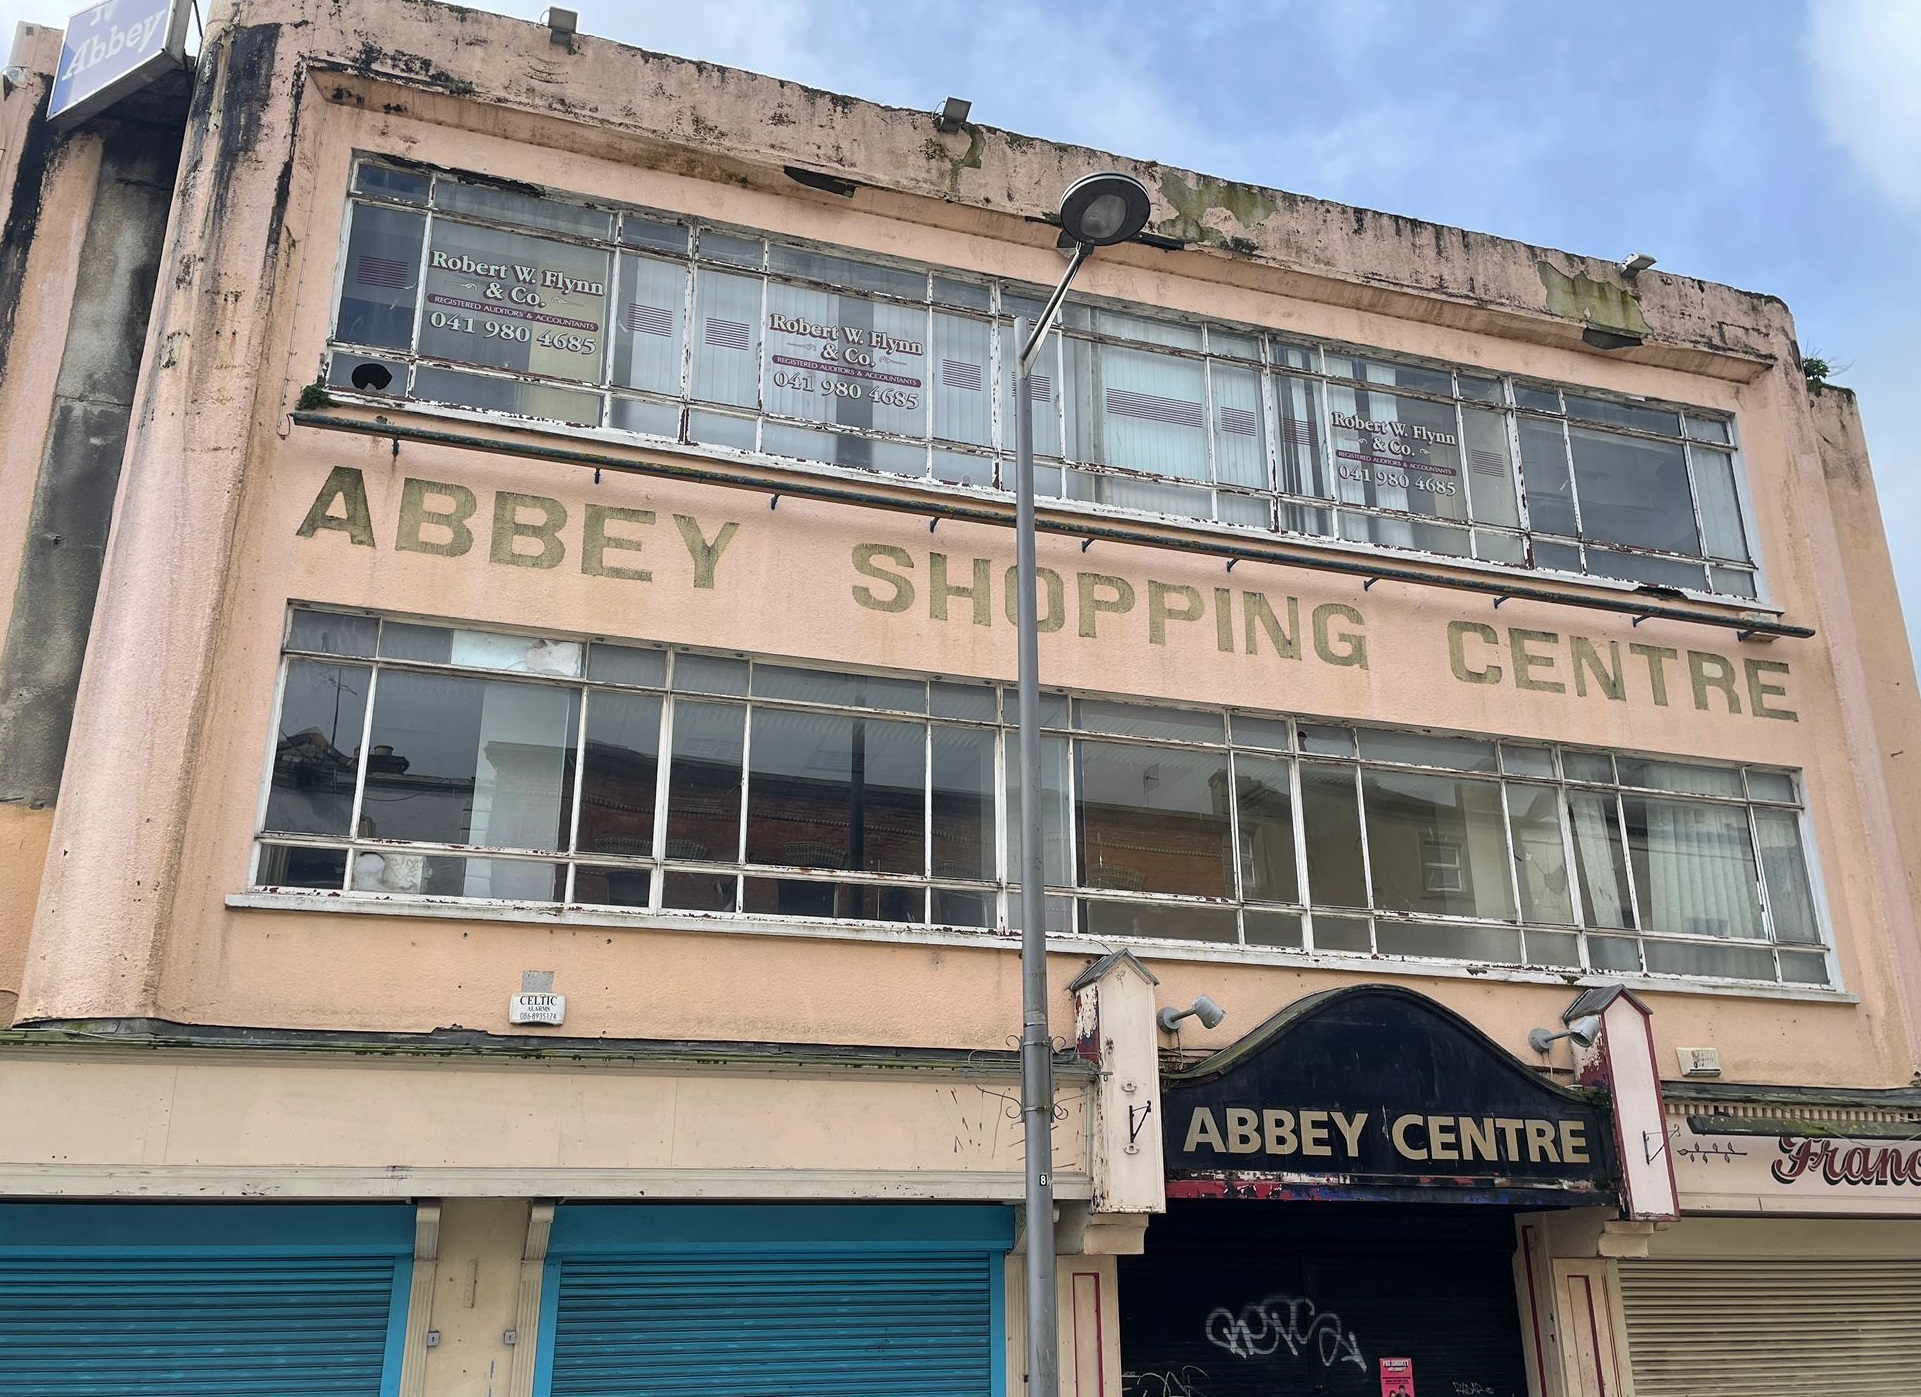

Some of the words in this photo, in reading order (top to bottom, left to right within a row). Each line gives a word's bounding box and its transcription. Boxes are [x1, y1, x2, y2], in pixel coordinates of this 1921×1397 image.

[62, 9, 166, 81] Abbey
[429, 250, 507, 280] Robert
[511, 264, 537, 285] W.
[541, 270, 605, 297] Flynn
[483, 282, 504, 301] &
[508, 286, 547, 308] Co.
[434, 295, 482, 311] REGISTERED
[483, 304, 524, 318] AUDITORS
[526, 312, 533, 320] &
[535, 314, 596, 331] ACCOUNTANTS
[430, 311, 476, 334] 041
[483, 321, 531, 343] 980
[536, 330, 597, 355] 4685
[770, 313, 839, 341] Robert
[842, 326, 864, 345] W.
[869, 331, 924, 356] Flynn
[777, 356, 818, 369] REGISTERED
[819, 364, 855, 376] AUDITORS
[864, 371, 918, 386] ACCOUNTANTS
[821, 343, 839, 361] &
[843, 347, 876, 367] Co.
[774, 371, 815, 392] 041
[821, 379, 862, 400] 980
[868, 385, 920, 410] 4685
[1332, 411, 1388, 434] Robert
[1390, 421, 1408, 437] W.
[1412, 425, 1457, 446] Flynn
[1372, 436, 1386, 452] &
[1388, 440, 1416, 456] Co.
[1338, 451, 1372, 462] REGISTERED
[1373, 457, 1402, 467] AUDITORS
[1409, 463, 1452, 475] ACCOUNTANTS
[1339, 465, 1372, 482] 041
[1376, 471, 1410, 488] 980
[1415, 476, 1456, 496] 4685
[295, 465, 740, 589] ABBEY
[851, 543, 1369, 671] SHOPPING
[1447, 620, 1799, 723] CENTRE
[520, 995, 558, 1006] CELTIC
[1183, 1106, 1368, 1157] ABBEY
[1392, 1113, 1591, 1164] CENTRE
[1040, 1175, 1047, 1186] 8
